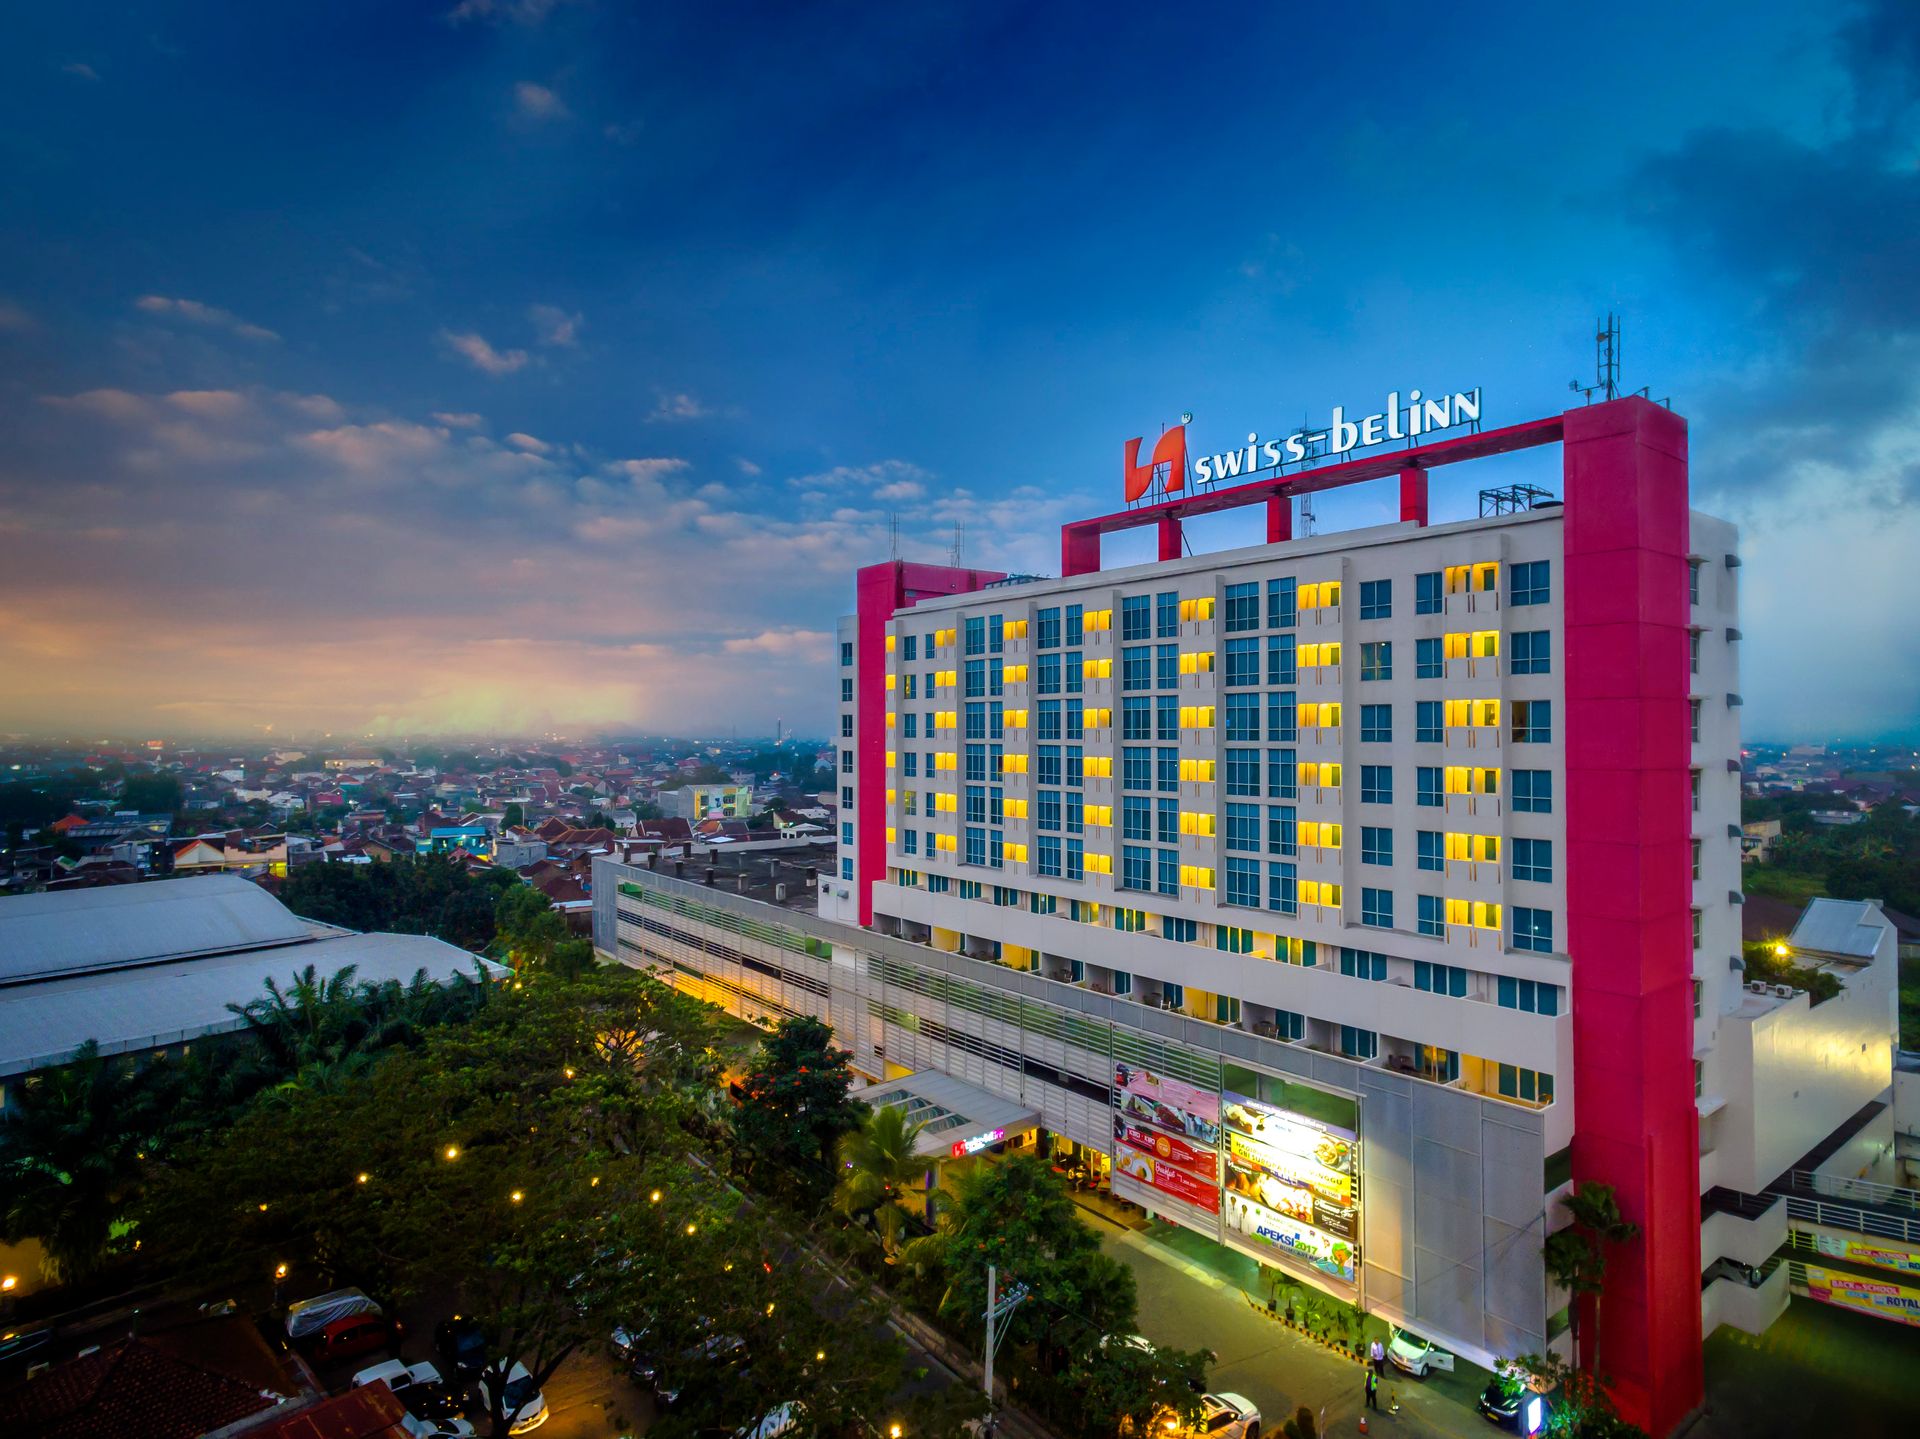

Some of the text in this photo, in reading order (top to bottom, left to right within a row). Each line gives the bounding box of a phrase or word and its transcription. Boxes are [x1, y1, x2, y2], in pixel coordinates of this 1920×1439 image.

[1256, 1225, 1295, 1247] APEKSI
[1294, 1240, 1318, 1255] 2017
[1831, 1280, 1855, 1289] BACK
[1862, 1283, 1898, 1295] SCHOOL
[1886, 1296, 1920, 1308] ROYAL
